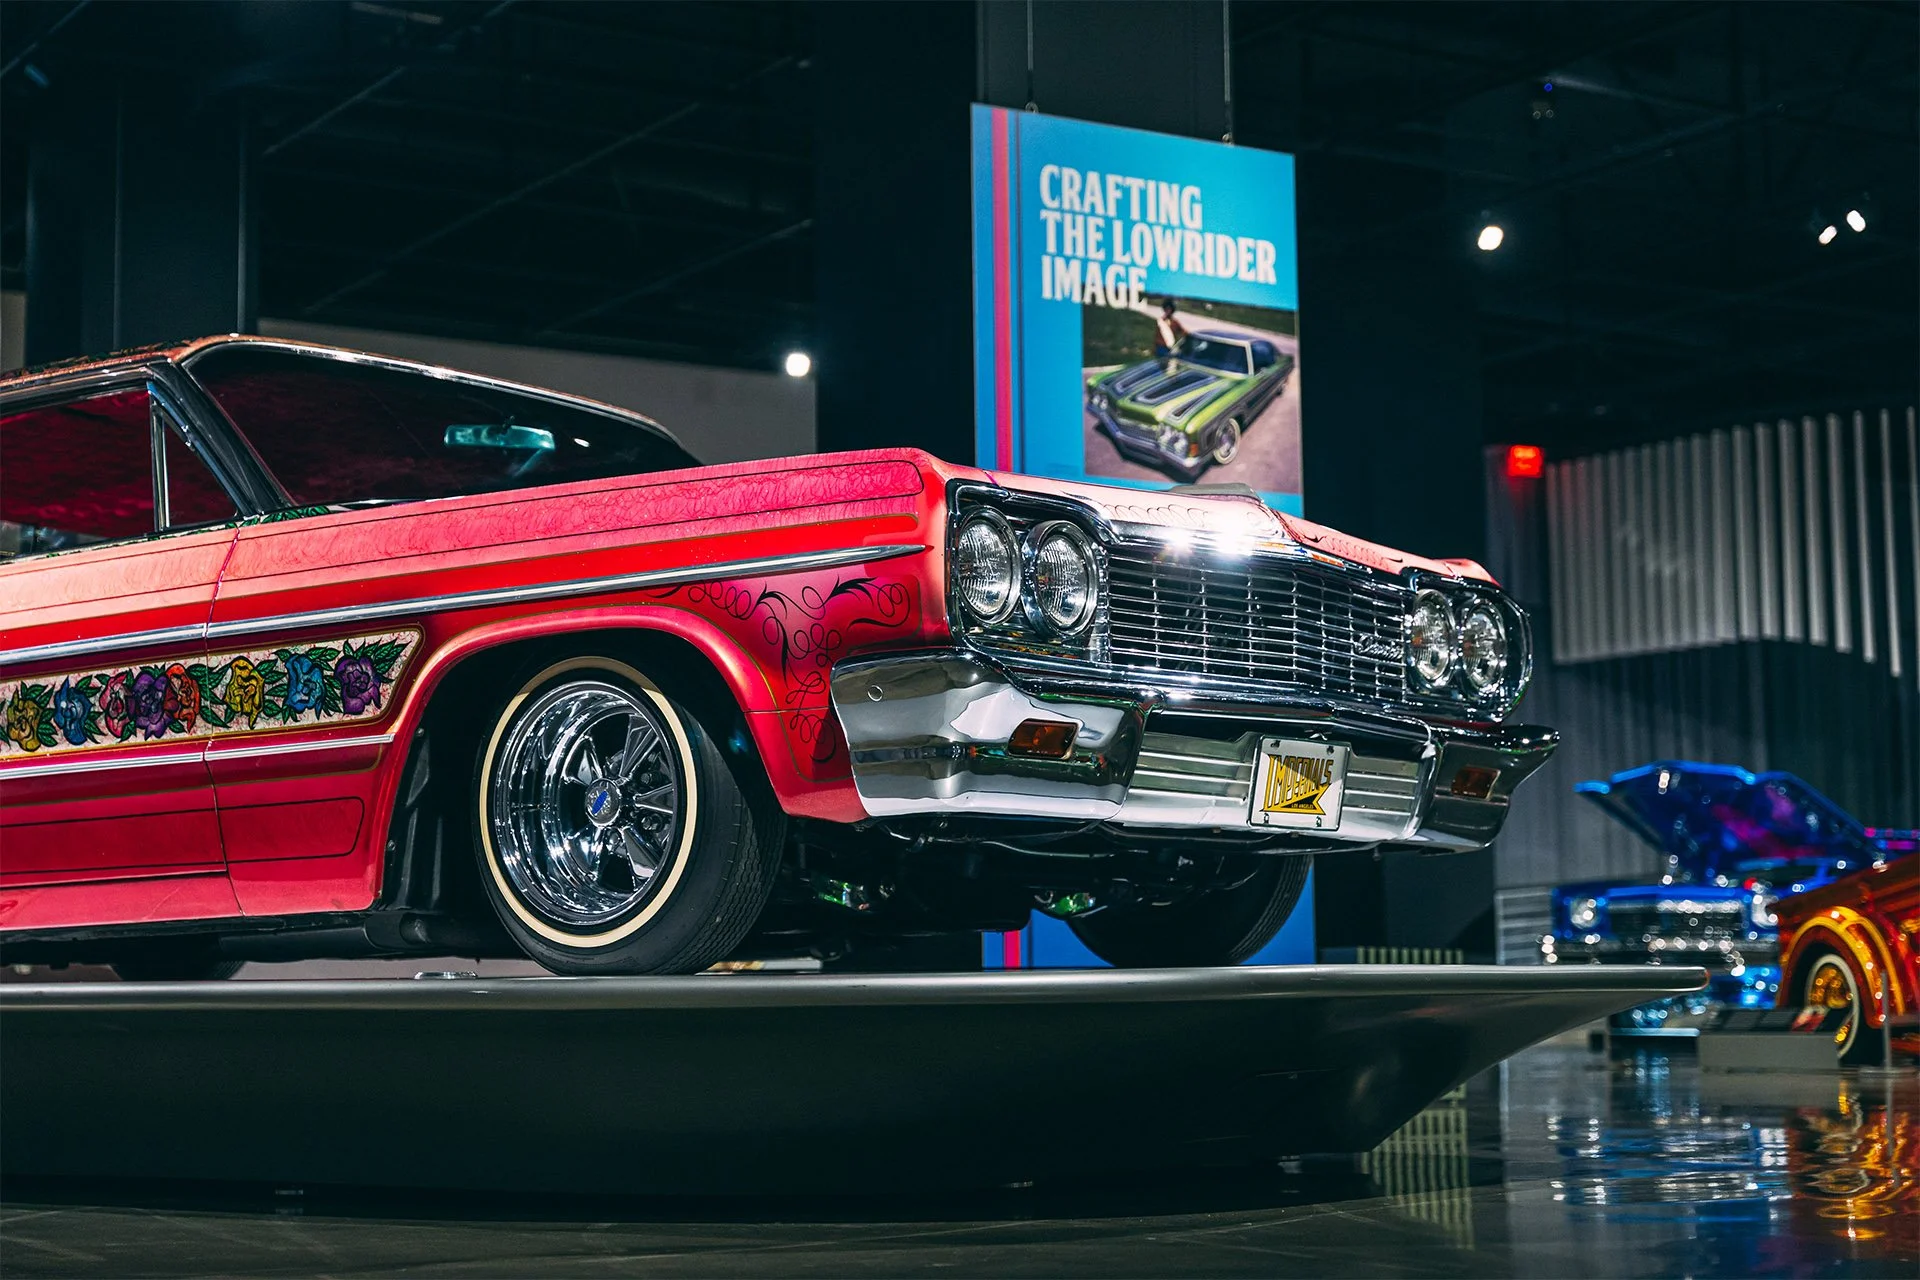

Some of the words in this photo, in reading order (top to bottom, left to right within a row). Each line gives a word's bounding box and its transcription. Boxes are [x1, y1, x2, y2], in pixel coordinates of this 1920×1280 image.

[1039, 164, 1202, 230] CRAFTING
[1039, 209, 1105, 261] THE
[1112, 220, 1277, 285] LOWRIDER
[1040, 255, 1148, 311] IMAGE
[1263, 754, 1334, 809] IMPERIALS
